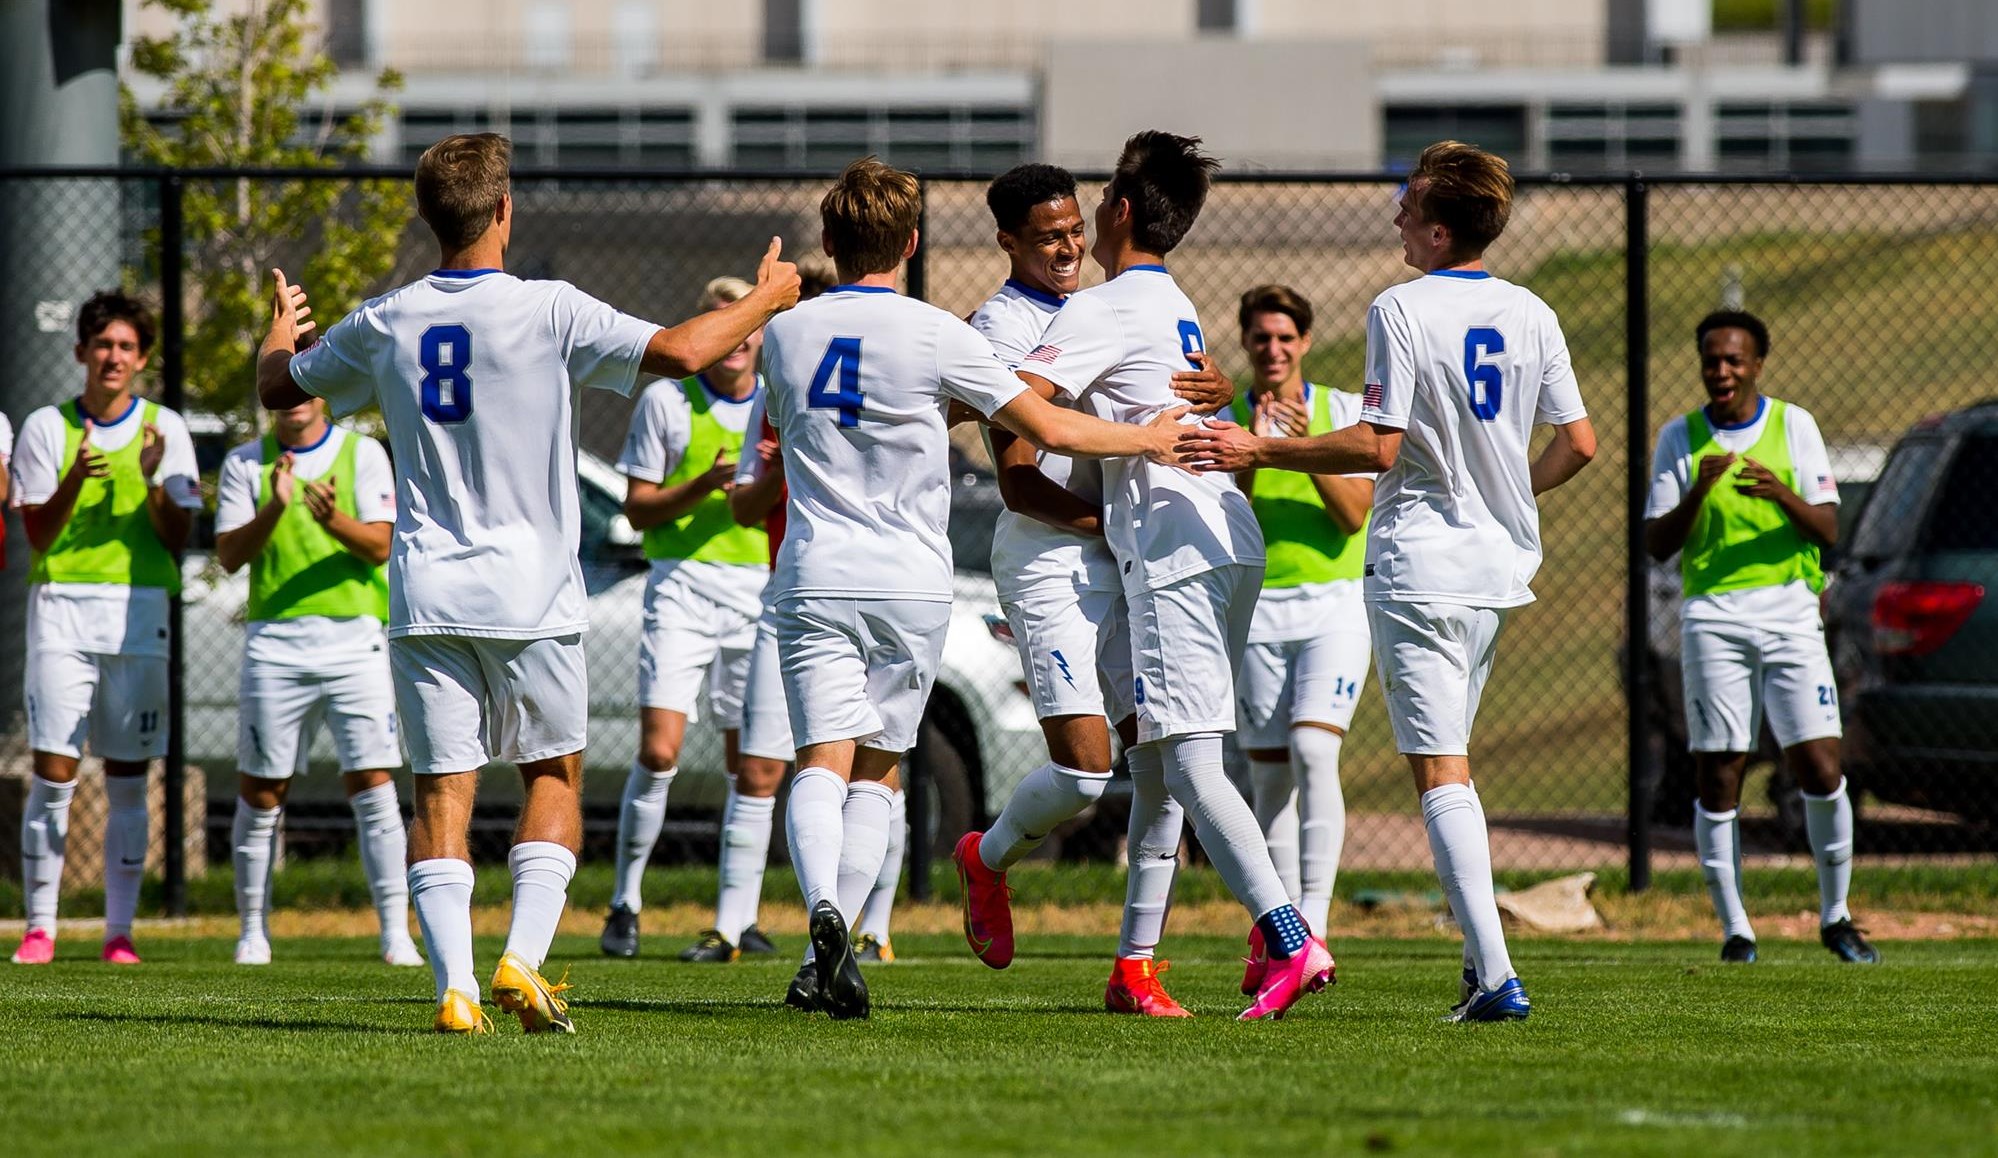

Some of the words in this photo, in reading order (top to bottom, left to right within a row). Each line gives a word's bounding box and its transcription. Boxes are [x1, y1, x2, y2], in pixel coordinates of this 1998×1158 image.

[418, 322, 474, 425] 8
[806, 335, 866, 429] 4
[1463, 325, 1506, 423] 6
[1335, 677, 1355, 700] 14
